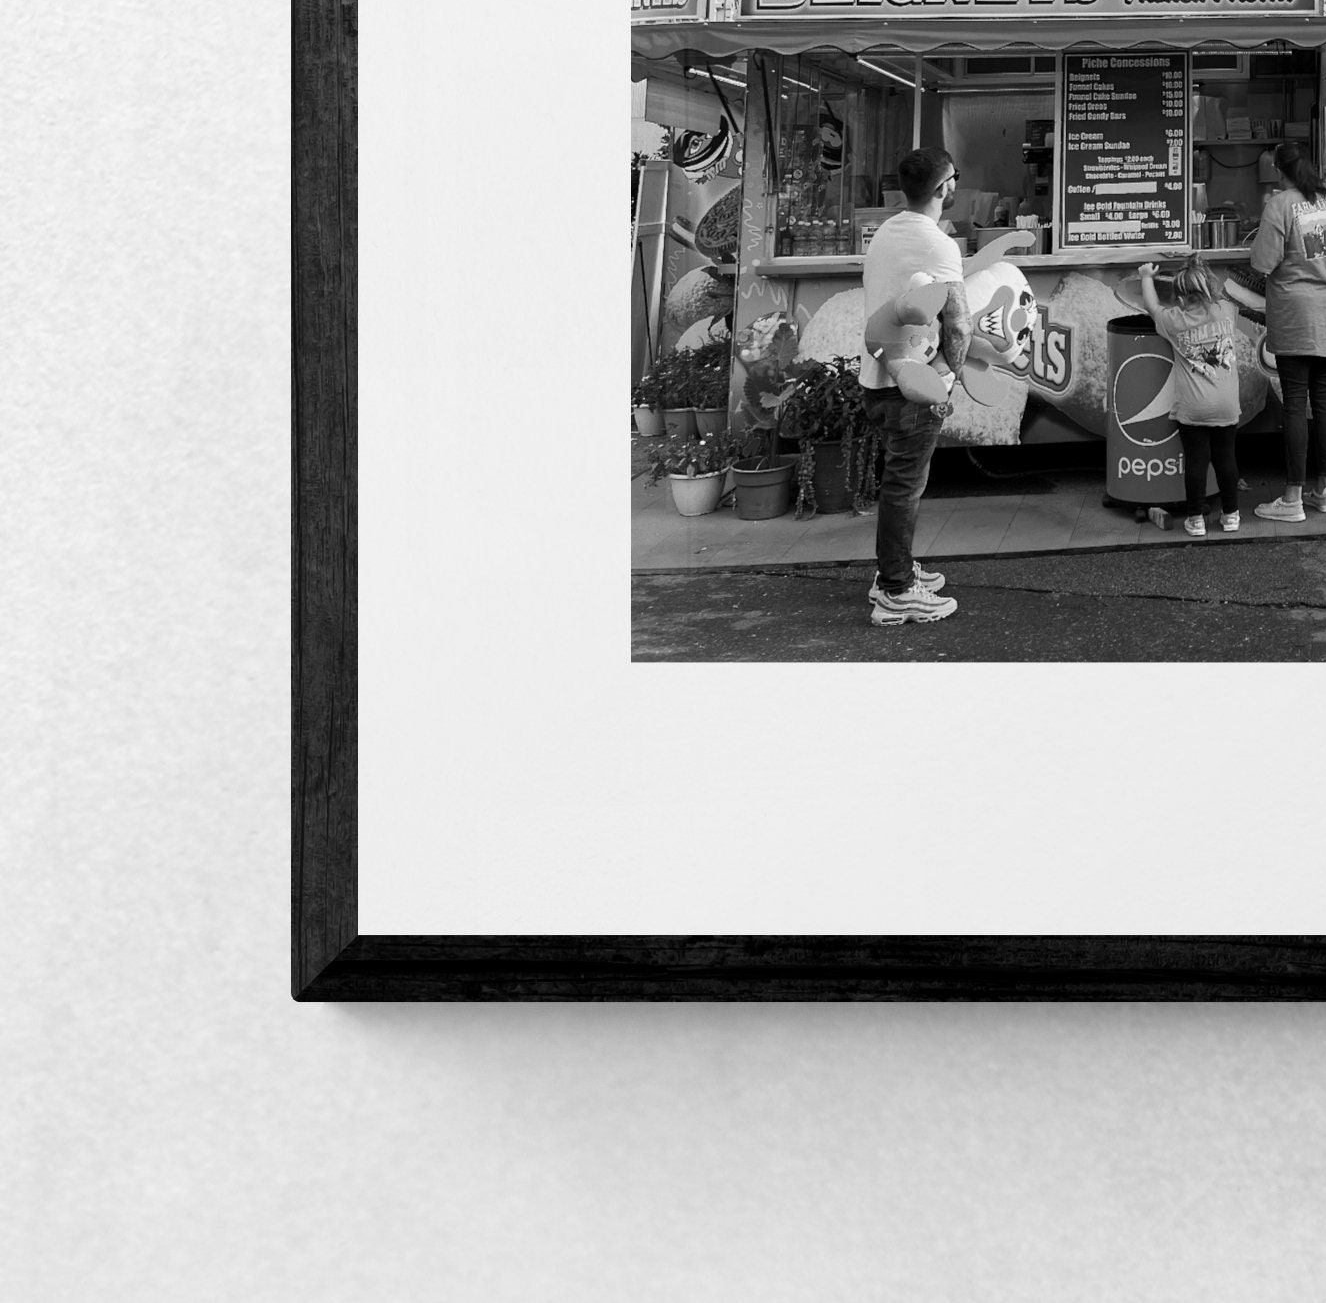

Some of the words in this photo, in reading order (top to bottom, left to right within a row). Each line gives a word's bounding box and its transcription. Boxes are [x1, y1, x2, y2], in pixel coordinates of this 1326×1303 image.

[1081, 57, 1109, 69] Piche
[1109, 57, 1171, 68] Concessions
[1069, 73, 1100, 82] Beignets
[1069, 83, 1093, 91] Funnel
[1093, 83, 1115, 91] Cakes
[1068, 92, 1092, 101] Funnel
[1092, 92, 1110, 101] Cake
[1110, 92, 1137, 101] Sundae
[1068, 102, 1087, 111] Fried
[1068, 112, 1087, 120] Fried
[1087, 112, 1109, 120] Candy
[1068, 132, 1080, 141] Ice
[1080, 132, 1104, 141] Cream
[1068, 142, 1080, 151] Ice
[1080, 142, 1104, 151] Cream
[1104, 141, 1131, 150] Sundae
[1067, 185, 1091, 194] Coffee
[1084, 202, 1096, 211] Ice
[1095, 202, 1113, 211] Cold
[1113, 201, 1144, 210] Fountain
[1144, 200, 1167, 209] Drinks
[1080, 212, 1101, 221] Small
[1128, 211, 1149, 219] Large
[1067, 233, 1080, 241] Ice
[1080, 232, 1097, 241] Cold
[1117, 452, 1185, 482] pepsi
